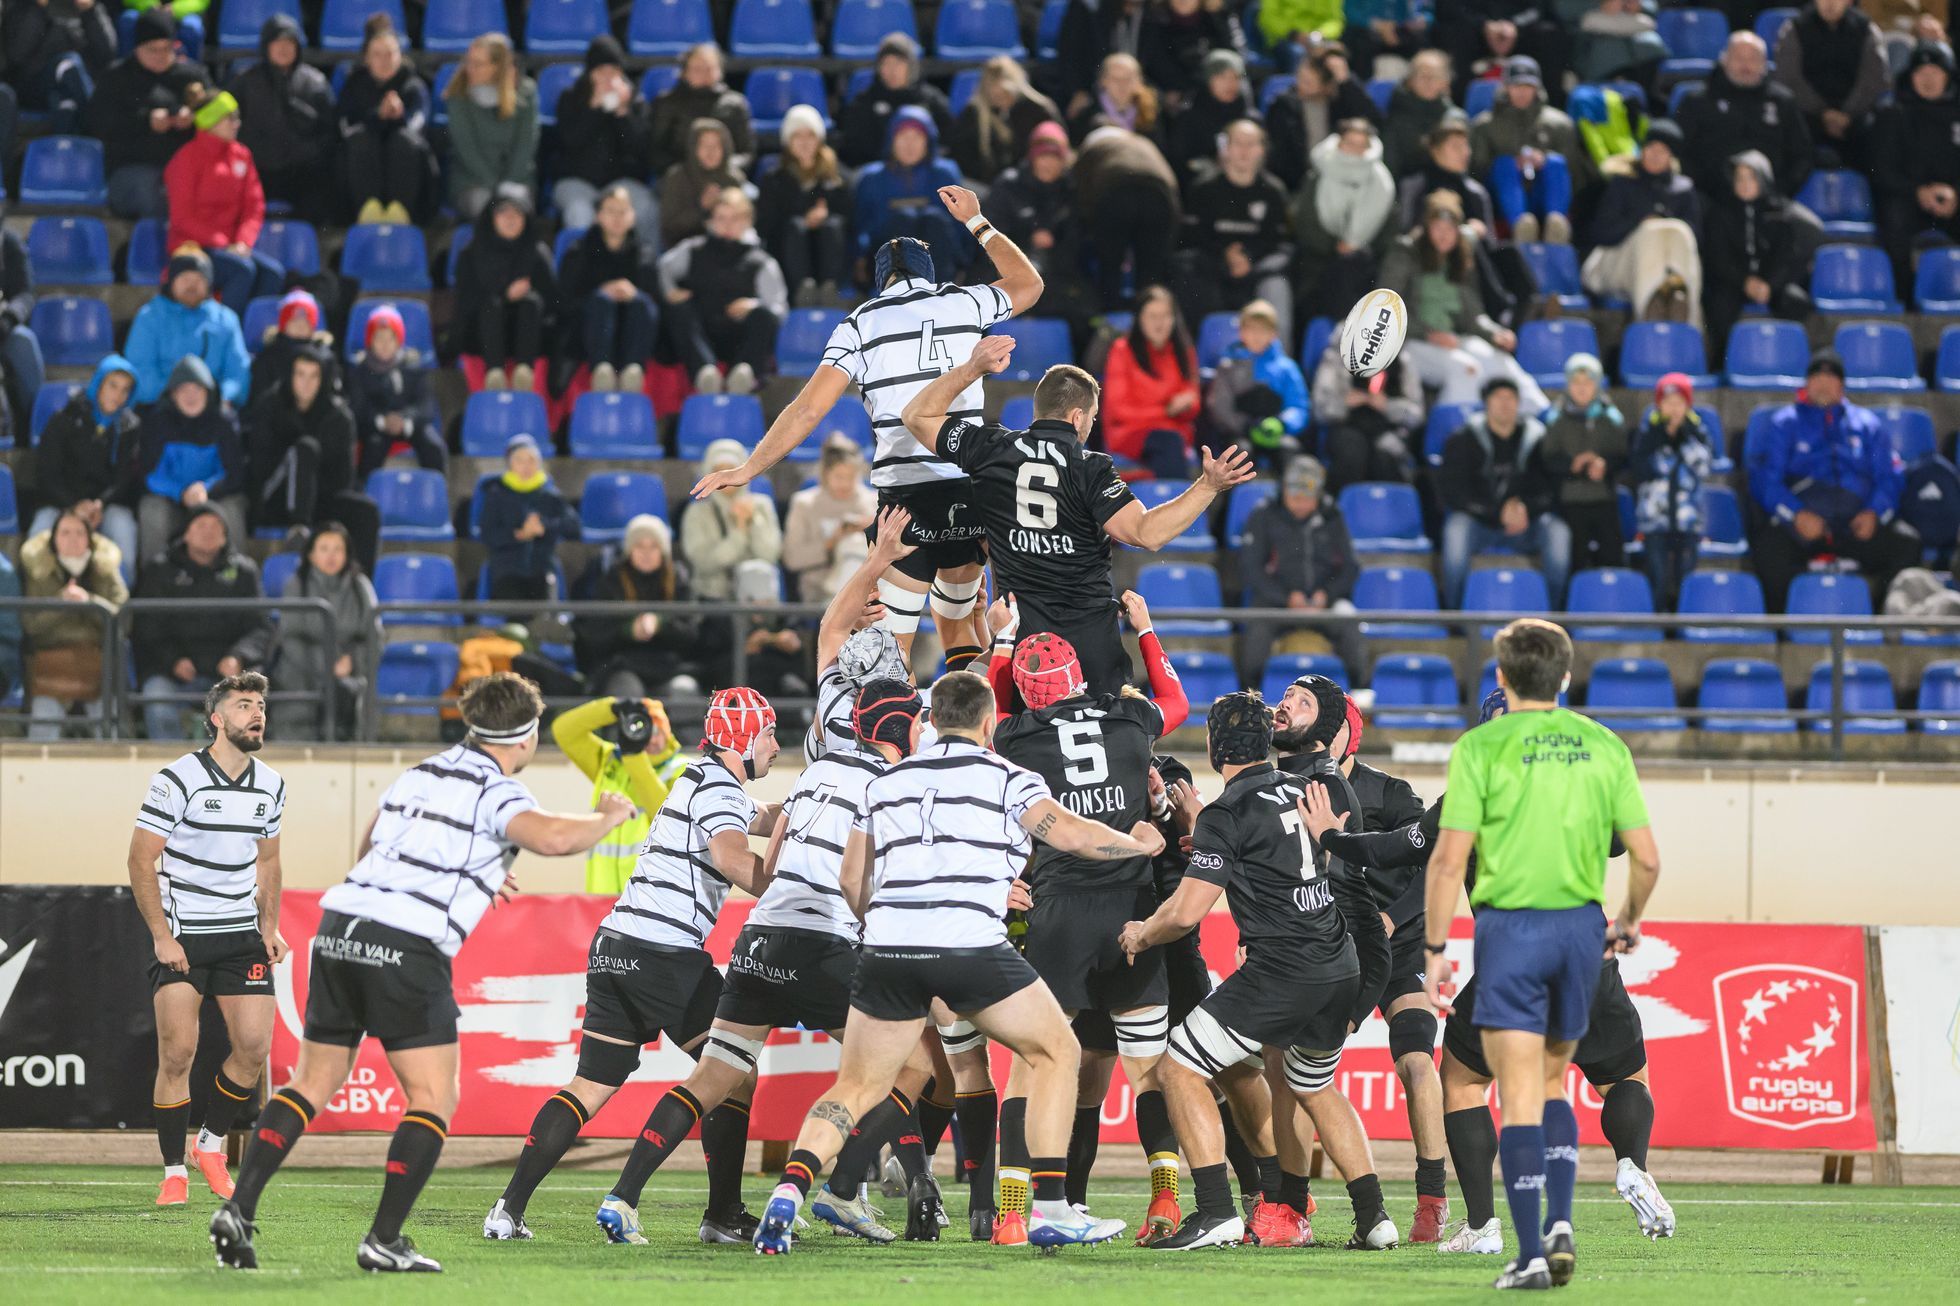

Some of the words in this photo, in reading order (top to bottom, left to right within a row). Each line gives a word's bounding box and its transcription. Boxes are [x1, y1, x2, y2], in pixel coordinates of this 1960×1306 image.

[918, 319, 953, 376] 4
[1360, 308, 1391, 366] RHINO
[1016, 461, 1059, 530] 6
[940, 526, 966, 539] DER
[968, 526, 986, 536] VAL
[1008, 529, 1076, 555] CONSEQ
[1523, 732, 1583, 747] rugby
[1058, 720, 1109, 787] 5
[1522, 751, 1591, 766] europe
[792, 783, 838, 844] 7
[919, 788, 939, 847] 1
[1034, 812, 1057, 838] 1970
[1279, 808, 1317, 881] 7
[335, 938, 363, 957] DER
[364, 942, 404, 967] VALK
[592, 955, 611, 968] DER
[610, 957, 641, 971] VALK
[766, 965, 799, 981] VALK
[0, 1053, 86, 1088] ron
[325, 1087, 394, 1113] GBY
[1748, 1076, 1833, 1099] rugby
[1741, 1096, 1843, 1116] europe
